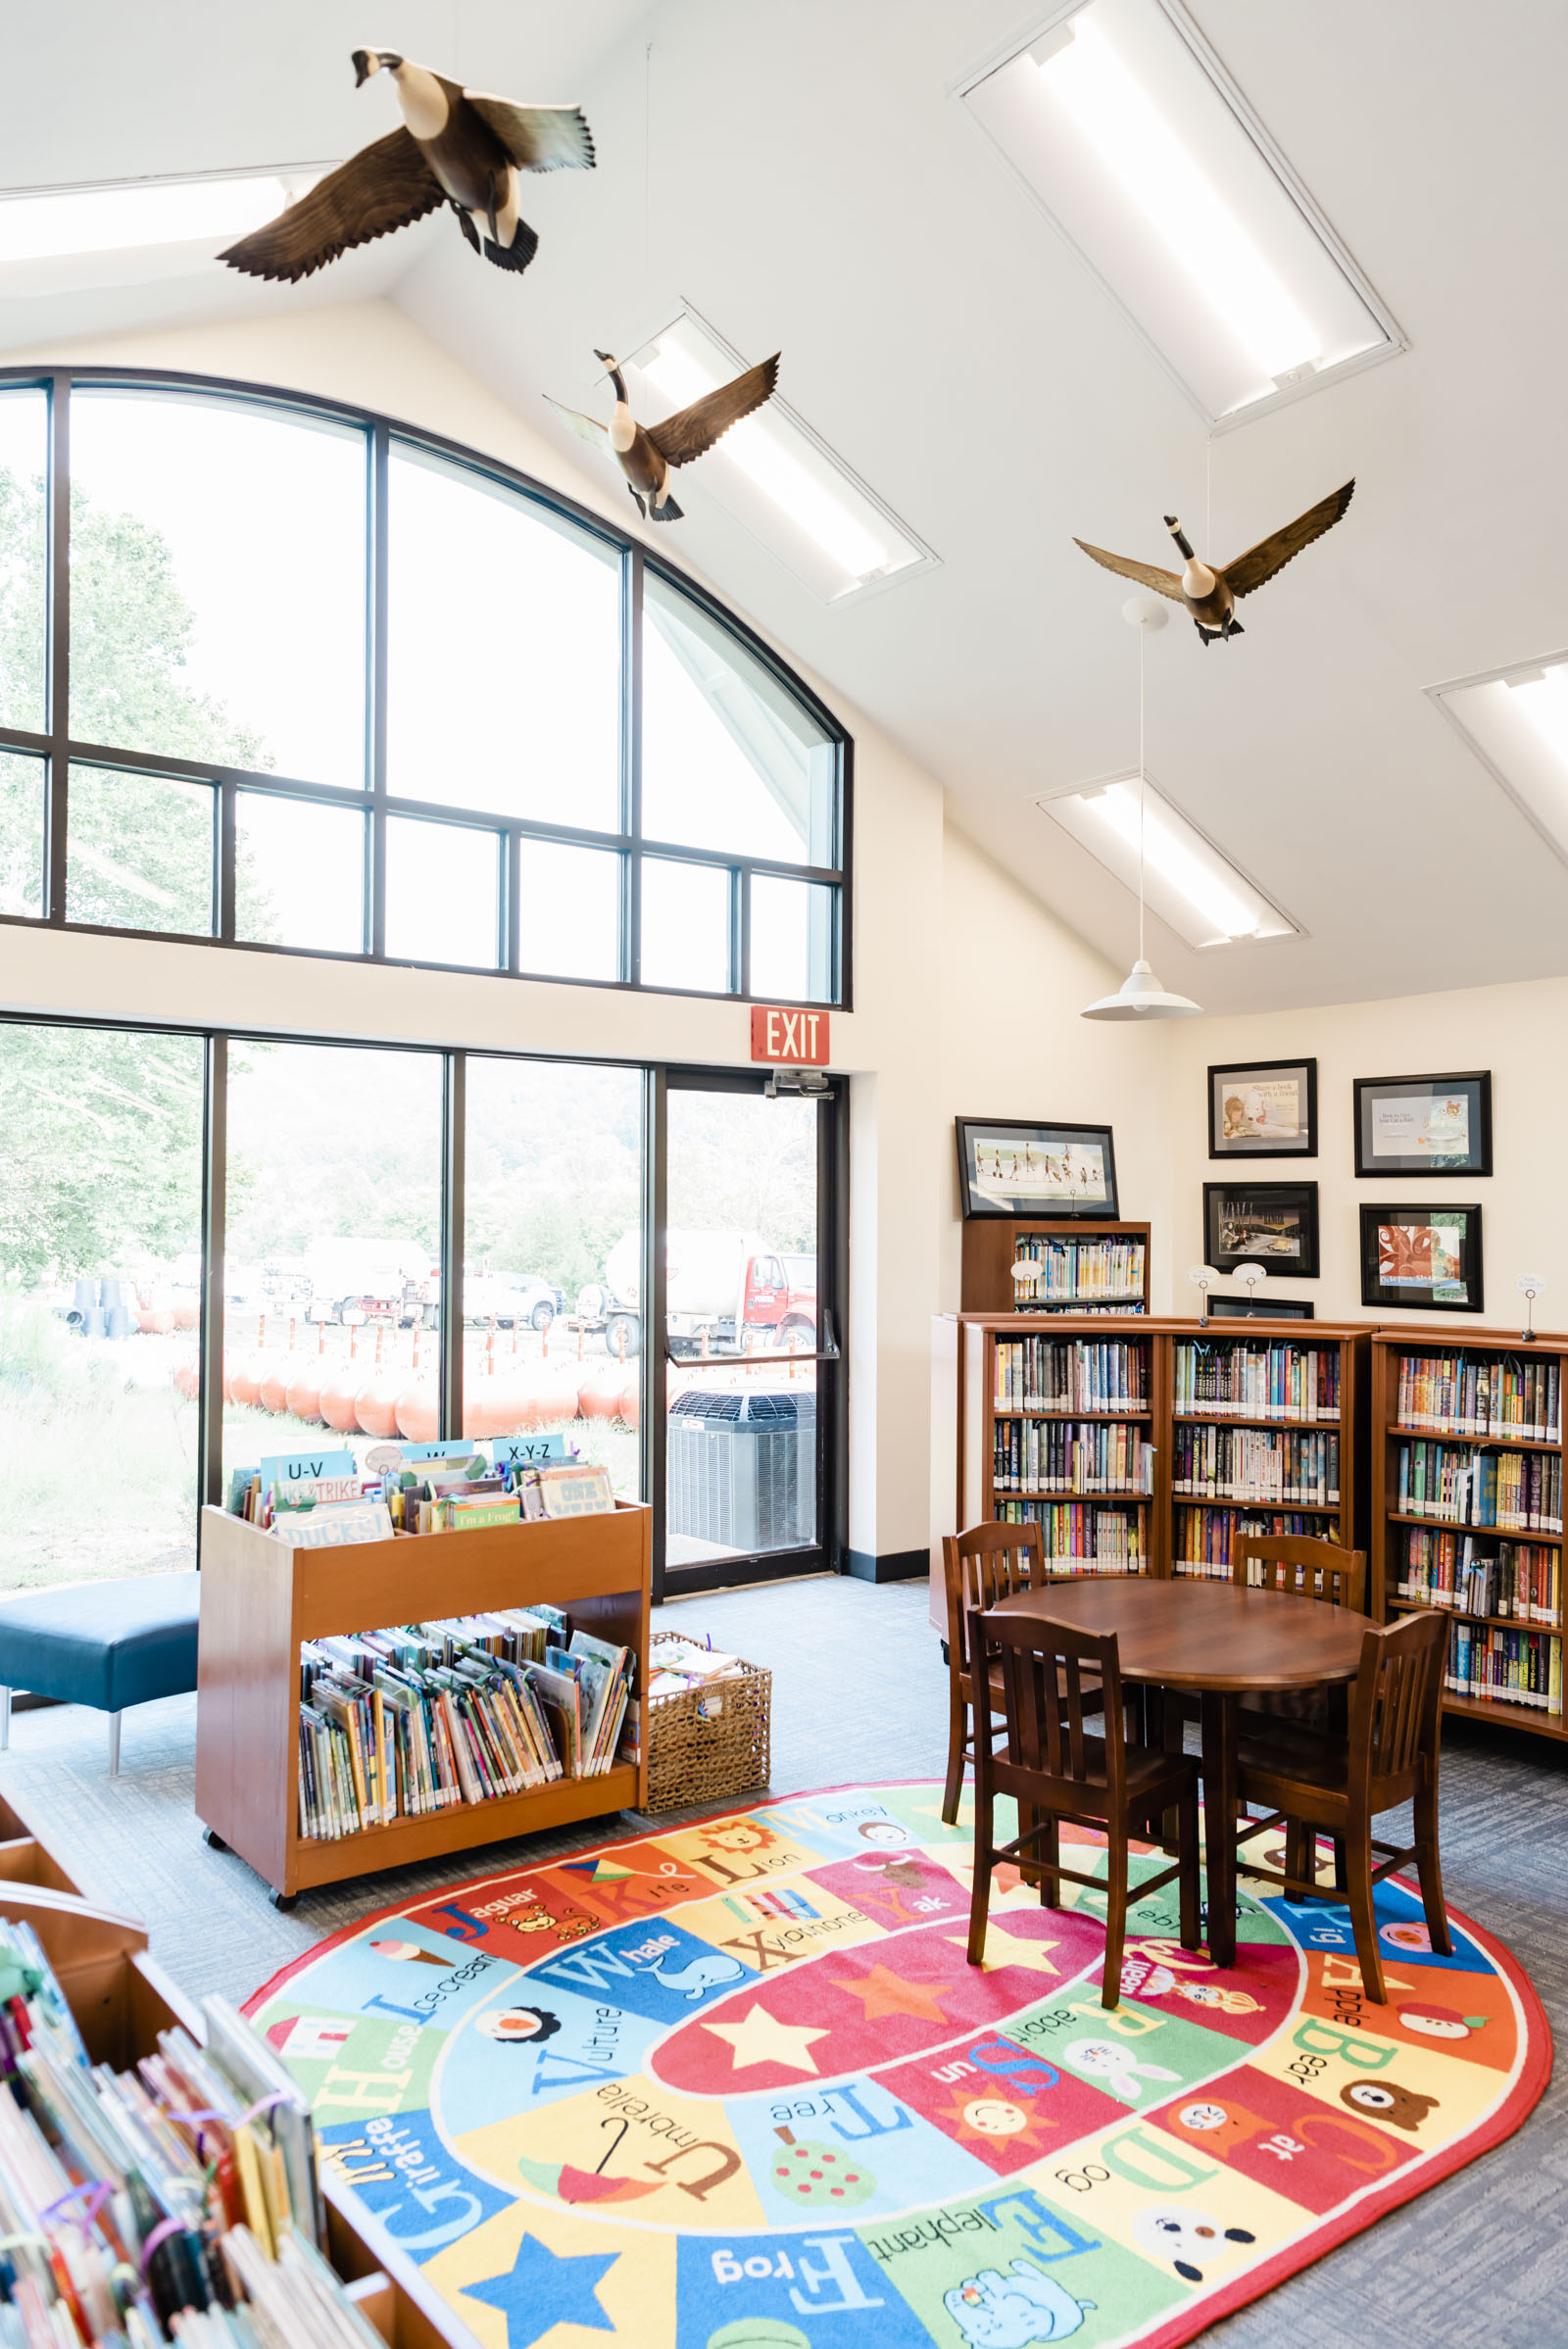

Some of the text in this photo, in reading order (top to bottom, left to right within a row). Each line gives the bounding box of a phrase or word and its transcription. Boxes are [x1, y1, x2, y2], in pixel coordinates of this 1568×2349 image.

[767, 1011, 819, 1058] EXIT
[288, 1461, 323, 1480] U-V
[509, 1444, 551, 1461] X-Y-Z
[283, 1512, 383, 1547] DUCKS!
[460, 1509, 515, 1527] I'm a Frog!
[757, 1805, 889, 1837] Monkey
[690, 1852, 803, 1884] Lion
[431, 1887, 540, 1941] Jaguar
[577, 1880, 690, 1922] Kite
[847, 1887, 952, 1923] Yak
[540, 1933, 681, 1990] Whale
[718, 1910, 868, 1972] Xylophone
[1004, 1992, 1168, 2043] Rabbit
[1321, 1953, 1417, 2028] Apple
[311, 2024, 423, 2114] House
[531, 2006, 628, 2095] Vulture
[931, 2035, 1059, 2096] Sun
[1283, 2018, 1399, 2085] Bear
[770, 2083, 914, 2141] Tree
[596, 2082, 742, 2203] Umbrella
[1054, 2126, 1221, 2193] Dog
[1256, 2113, 1397, 2177] Cat
[365, 2117, 482, 2251] Giraffe
[866, 2188, 1103, 2265] Elephant
[710, 2235, 886, 2315] Frog
